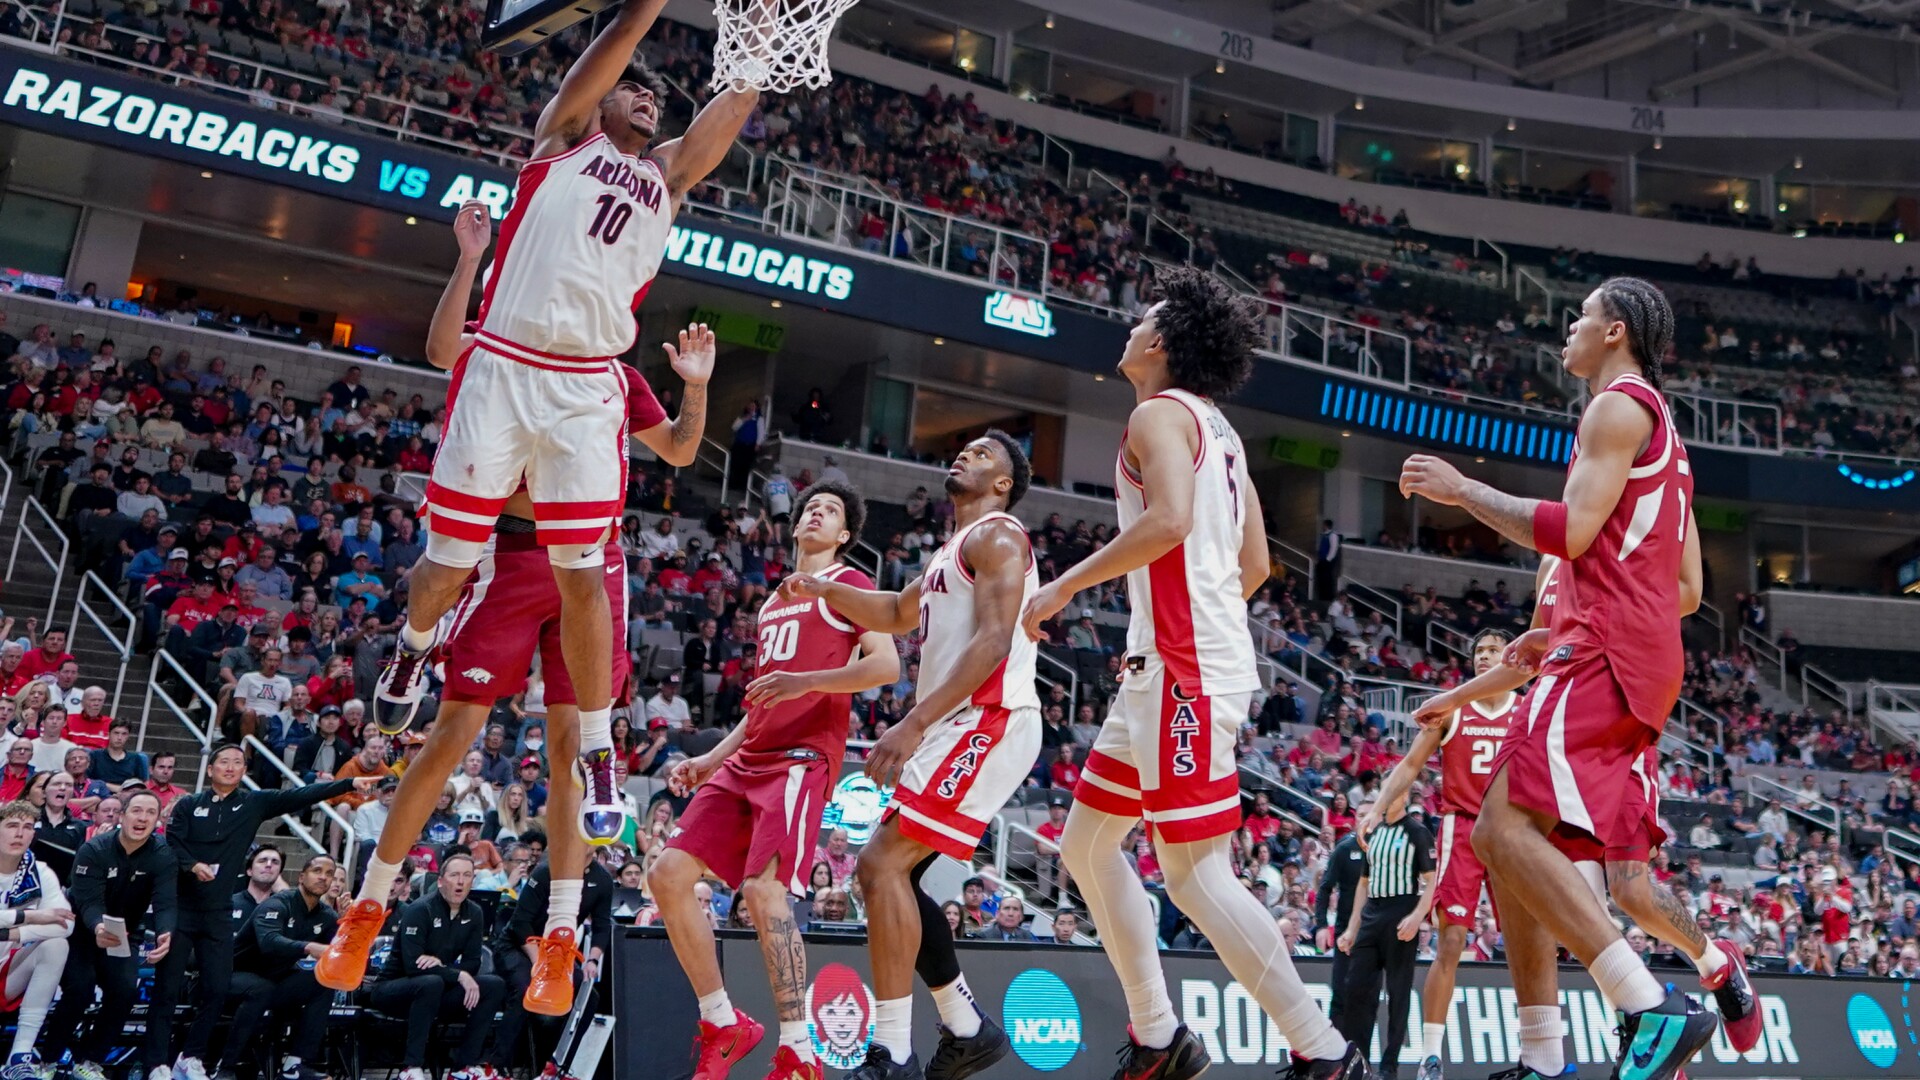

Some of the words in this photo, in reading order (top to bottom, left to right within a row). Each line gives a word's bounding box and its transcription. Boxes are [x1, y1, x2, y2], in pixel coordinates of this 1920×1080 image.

[1219, 31, 1253, 62] 203
[1631, 106, 1665, 133] 204
[3, 68, 360, 183] RAZORBACKS
[379, 159, 430, 198] VS
[664, 225, 854, 300] WILDCATS
[579, 155, 662, 216] ARIZONA
[587, 193, 633, 245] 10
[761, 602, 813, 624] ARKANSAS
[759, 619, 800, 668] 30
[1462, 727, 1508, 737] ARKANS
[937, 733, 993, 799] CATS
[1014, 1018, 1080, 1044] NCAA
[1856, 1029, 1898, 1049] NCAA
